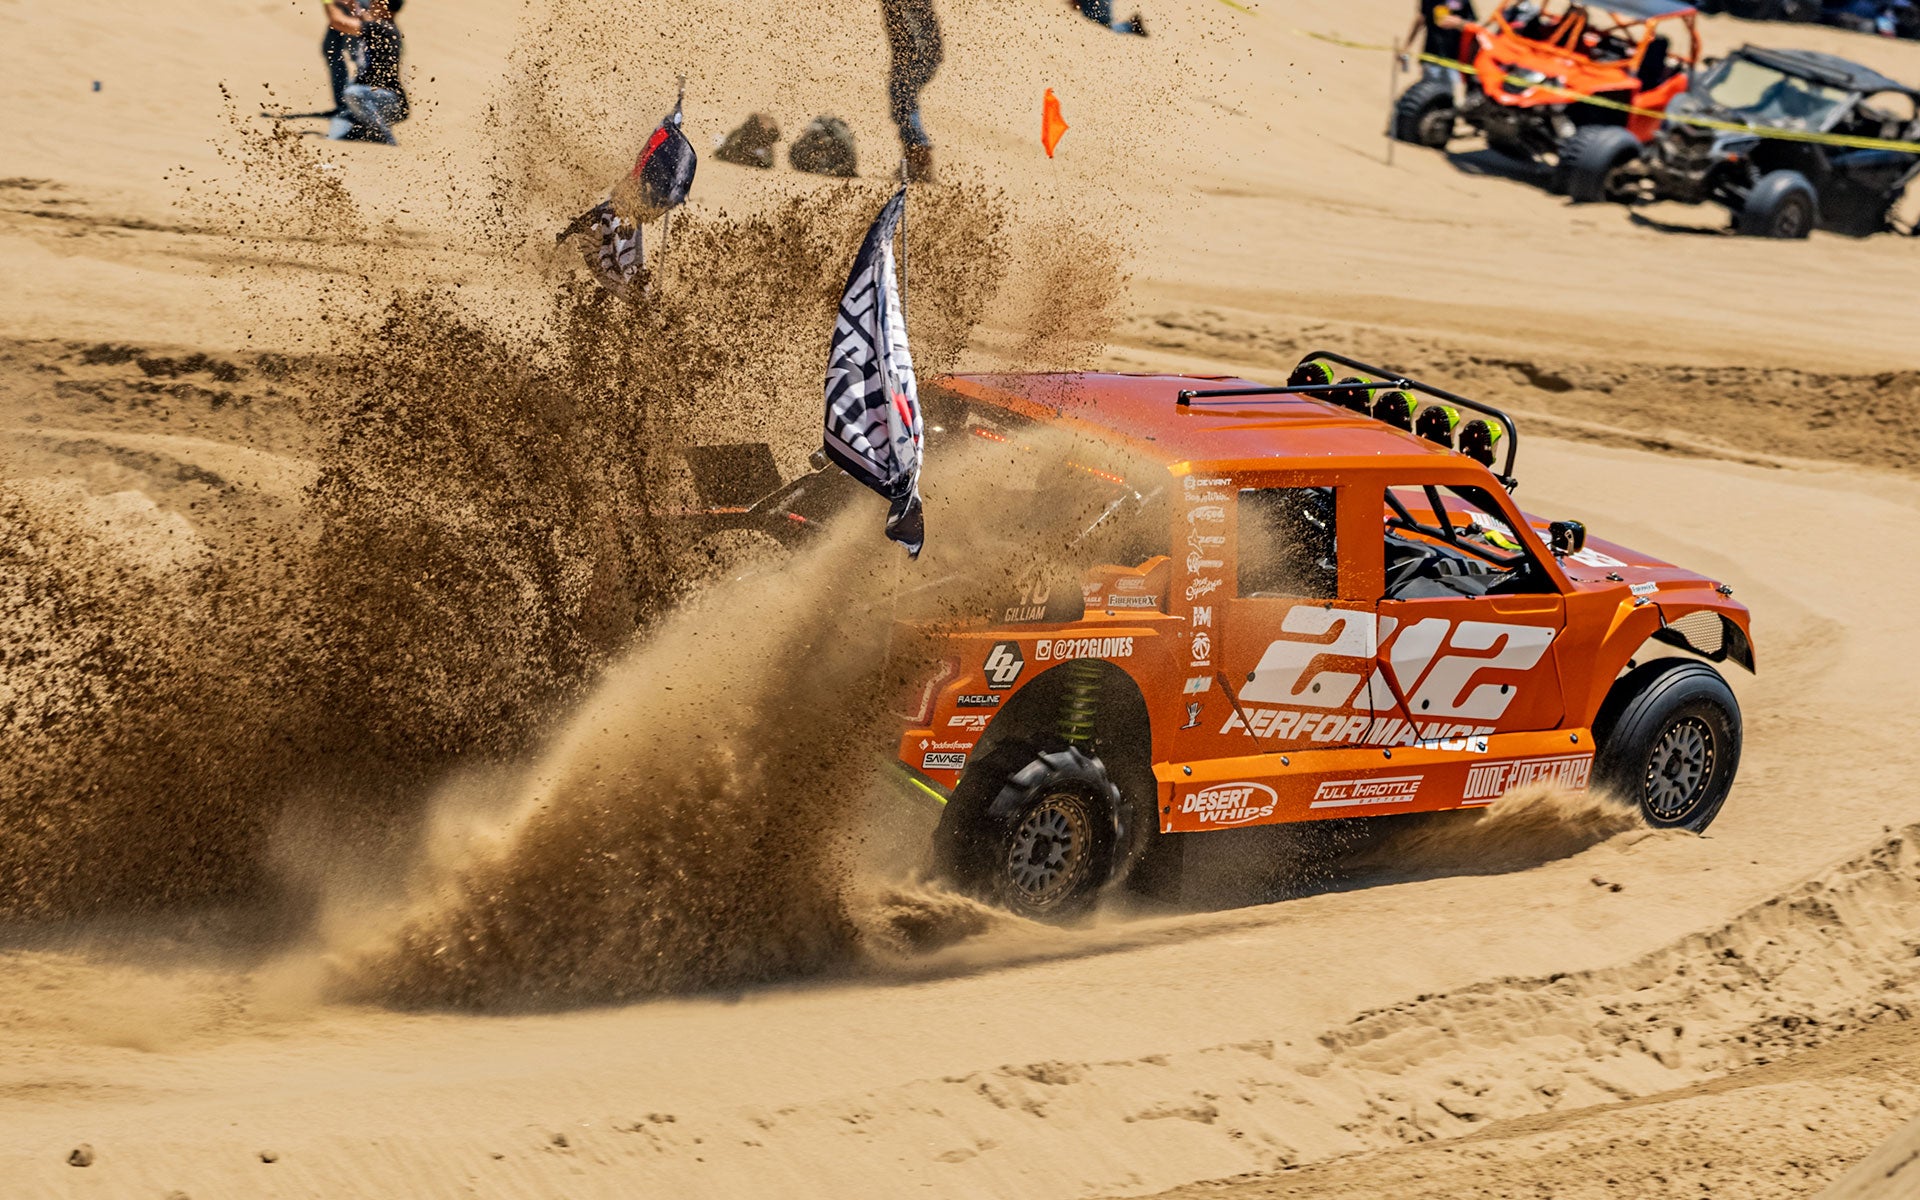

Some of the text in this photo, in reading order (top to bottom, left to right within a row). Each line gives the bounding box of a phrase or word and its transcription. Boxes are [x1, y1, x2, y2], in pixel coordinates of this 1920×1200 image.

[1196, 478, 1232, 487] DEVIANT
[1004, 605, 1046, 621] GILLIAM
[1053, 636, 1134, 660] @212GLOVES
[1238, 605, 1556, 720] 212
[957, 695, 1000, 704] RACELINE
[947, 714, 992, 727] EFX
[1219, 707, 1496, 754] PERFORMANCE
[925, 754, 965, 763] SAVAGE
[1314, 775, 1424, 800] FULL THROTTLE
[1182, 788, 1254, 814] DESERT
[1200, 805, 1274, 823] WHIPS
